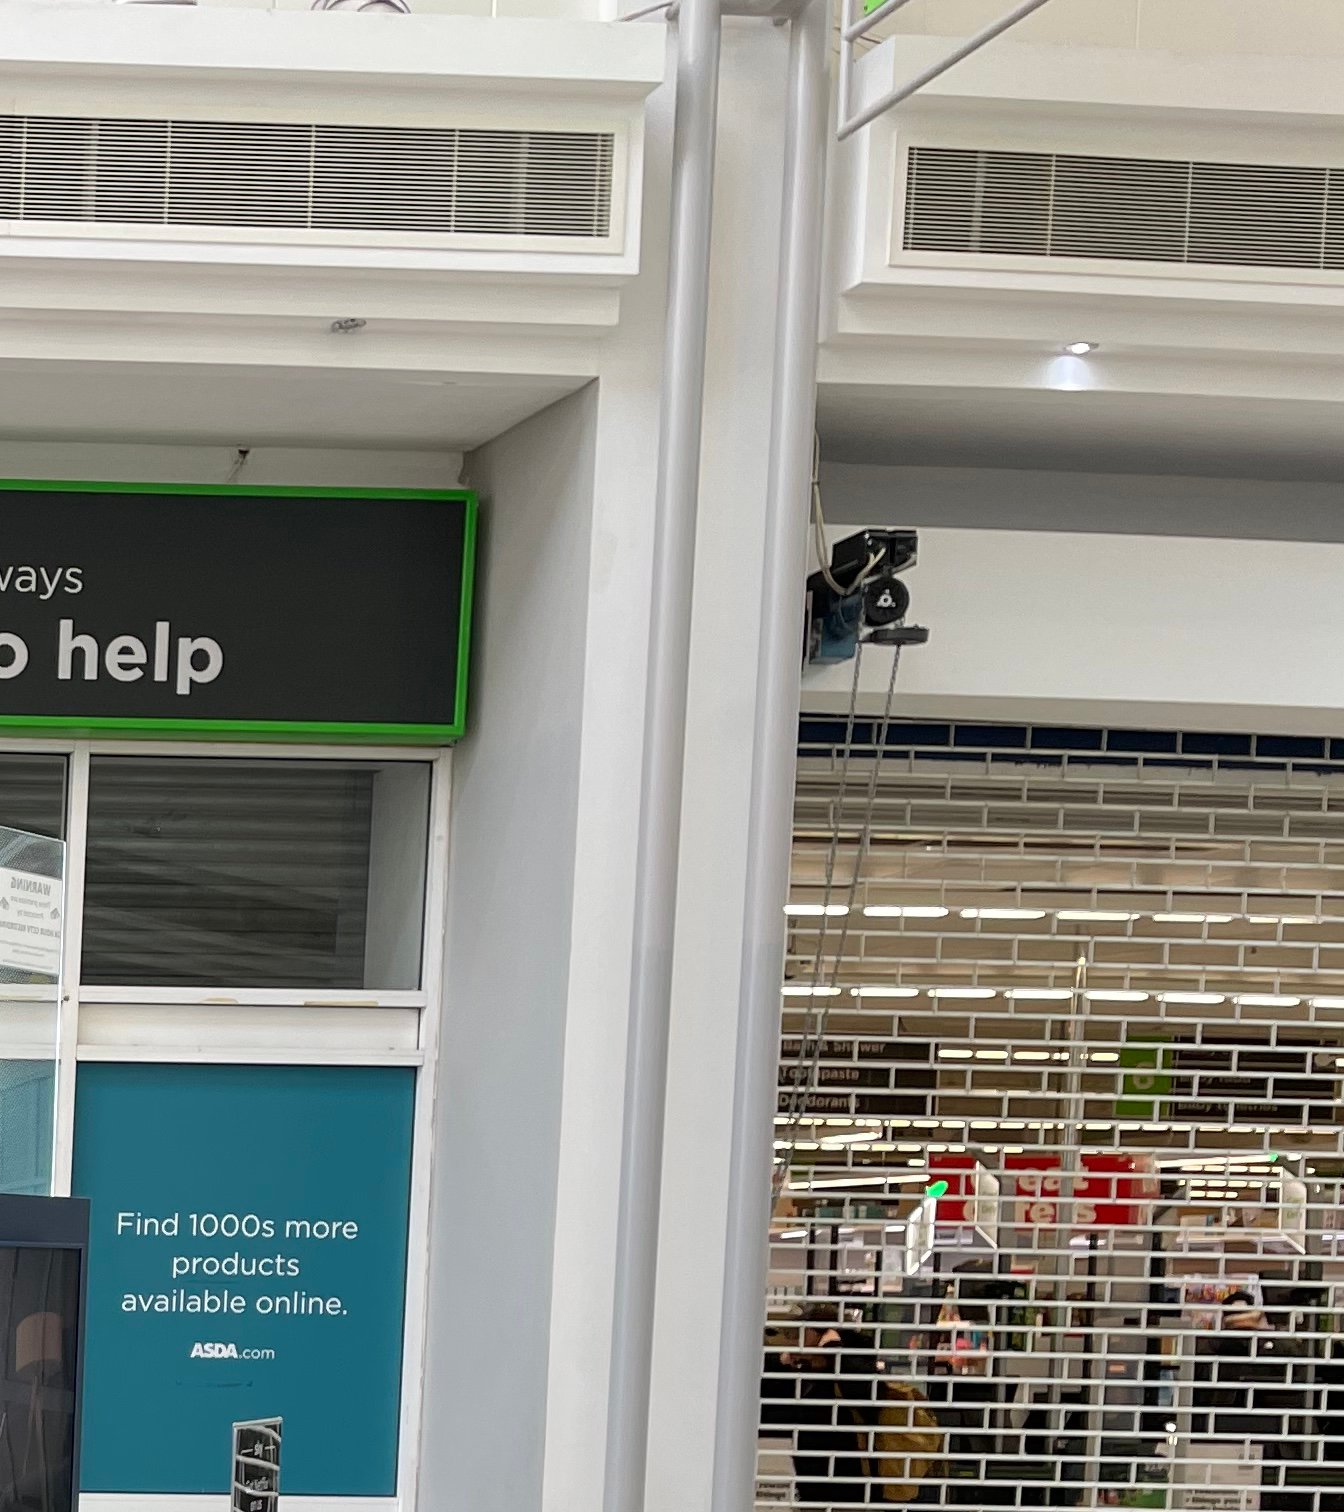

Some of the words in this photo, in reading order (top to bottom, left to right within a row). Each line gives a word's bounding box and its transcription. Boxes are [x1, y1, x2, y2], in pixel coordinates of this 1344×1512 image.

[57, 619, 224, 695] help
[117, 1212, 179, 1236] Find
[189, 1214, 275, 1238] 1000s
[285, 1219, 359, 1240] more
[172, 1252, 300, 1279] products
[121, 1290, 246, 1314] available
[255, 1292, 348, 1316] online.
